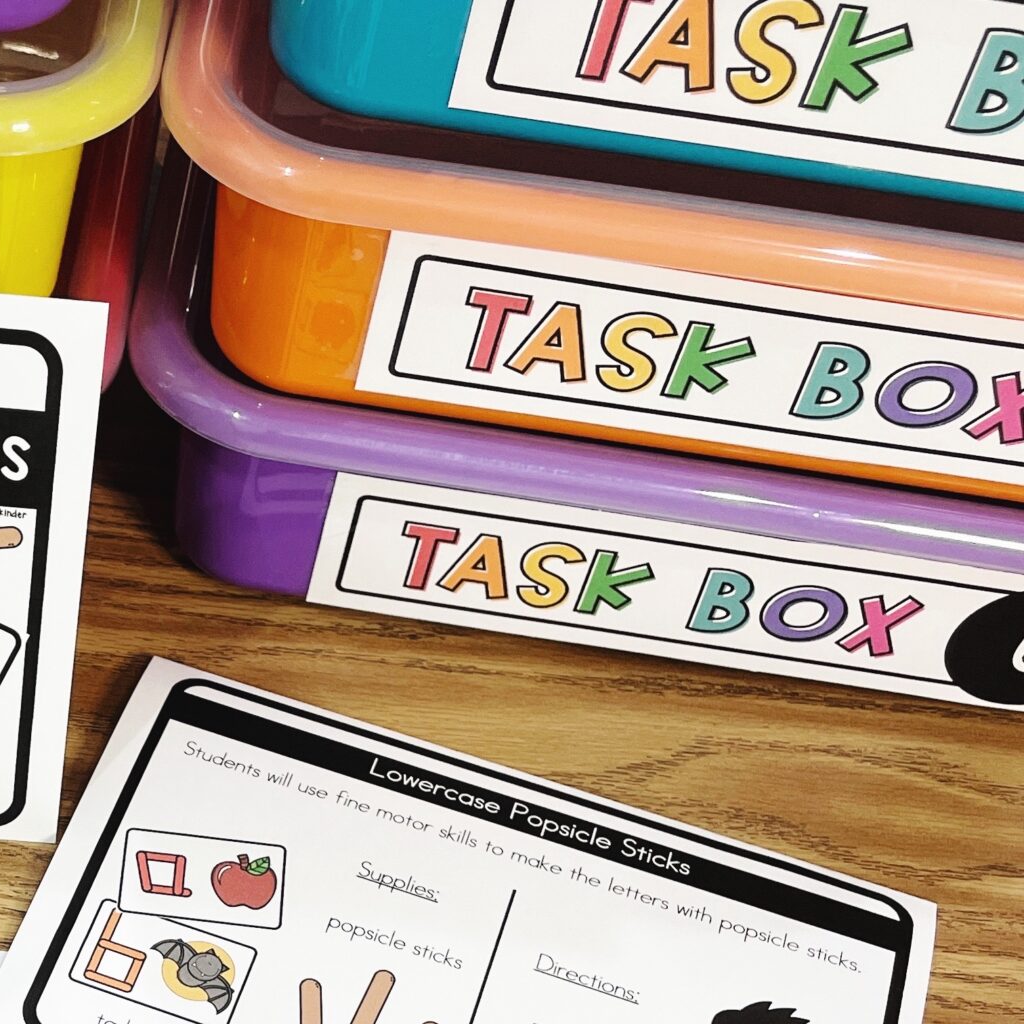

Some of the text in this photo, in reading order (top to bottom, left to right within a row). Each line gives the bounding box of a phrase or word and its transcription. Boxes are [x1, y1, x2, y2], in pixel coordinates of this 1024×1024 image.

[576, 0, 914, 112] TASK
[465, 286, 1024, 446] TASK BOX
[403, 523, 654, 615] TASK
[686, 567, 925, 657] BOX
[183, 740, 862, 974] Students will use fine motor skills to make the letters with popsicle sticks.
[369, 757, 691, 876] Lowercase Popsicle Sticks
[356, 860, 440, 903] Supplies:
[325, 917, 463, 970] popsicle sticks
[533, 953, 640, 1005] Directions:
